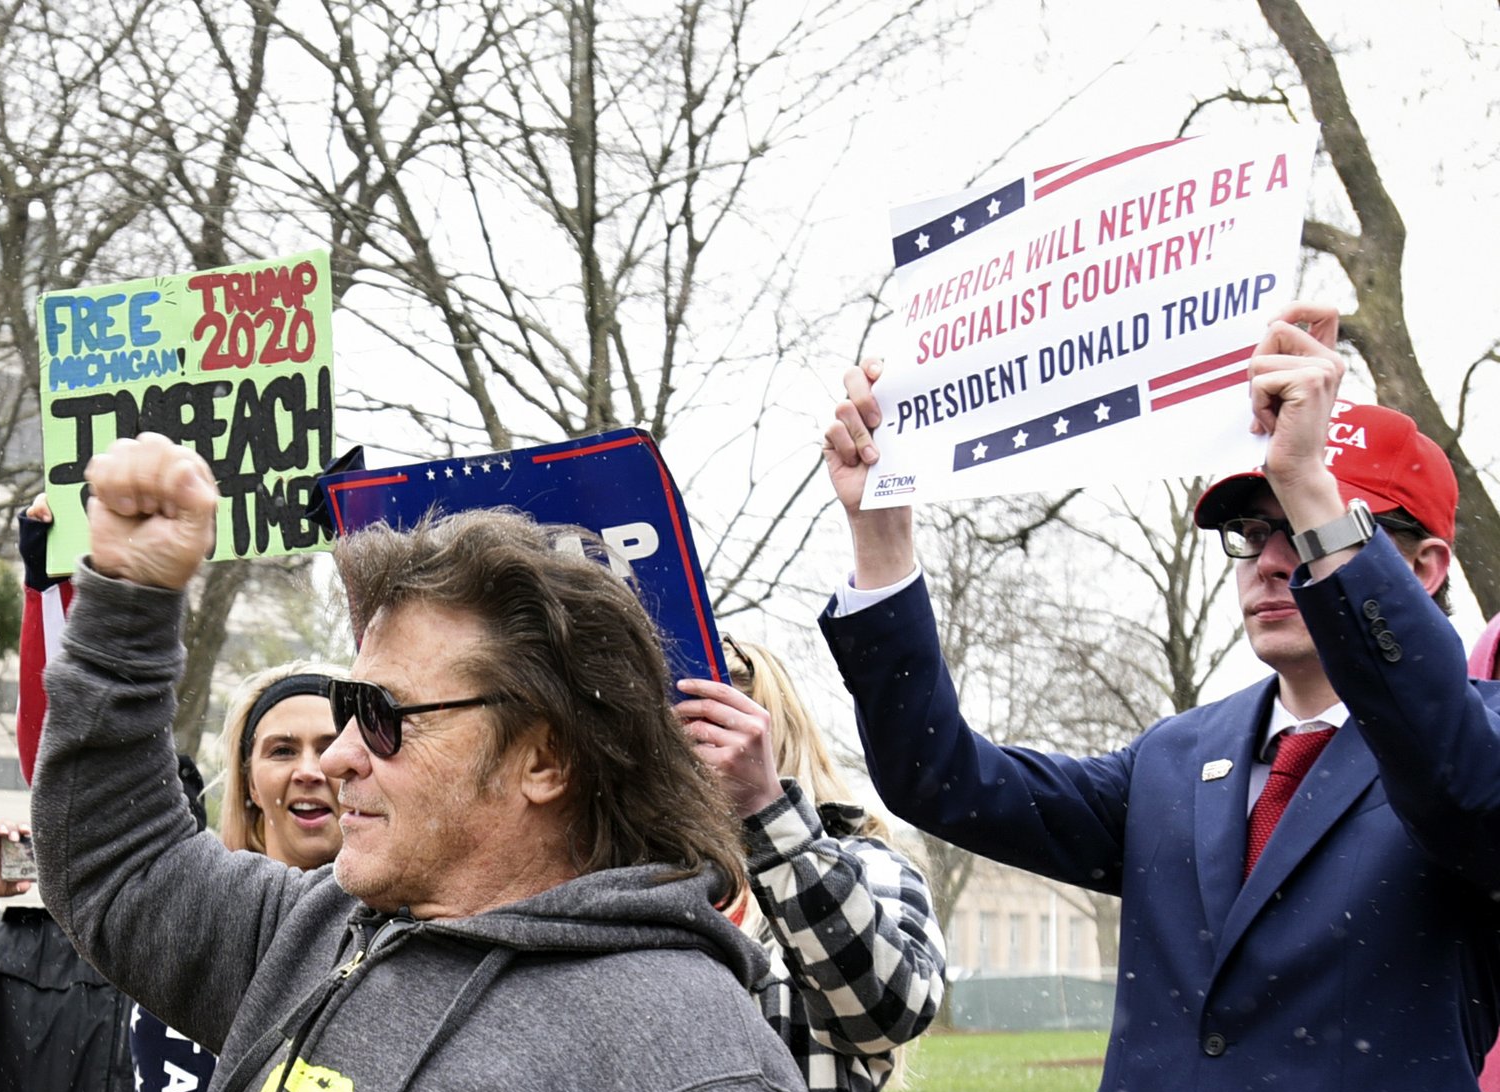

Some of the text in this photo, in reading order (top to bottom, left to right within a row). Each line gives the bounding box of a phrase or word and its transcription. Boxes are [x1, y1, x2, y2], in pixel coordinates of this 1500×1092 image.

[1025, 218, 1086, 274] WILL
[1098, 179, 1197, 246] NEVER
[1209, 160, 1255, 208] BE
[1265, 153, 1288, 192] A
[187, 260, 318, 316] TRUMP
[44, 291, 161, 356] FREE
[193, 306, 316, 371] 2020
[887, 273, 1277, 435] -PRESIDENT DONALD TRUMP
[916, 281, 1052, 365] SOCIALIST
[49, 347, 186, 392] MICHIGAN!
[876, 475, 916, 489] ACTION
